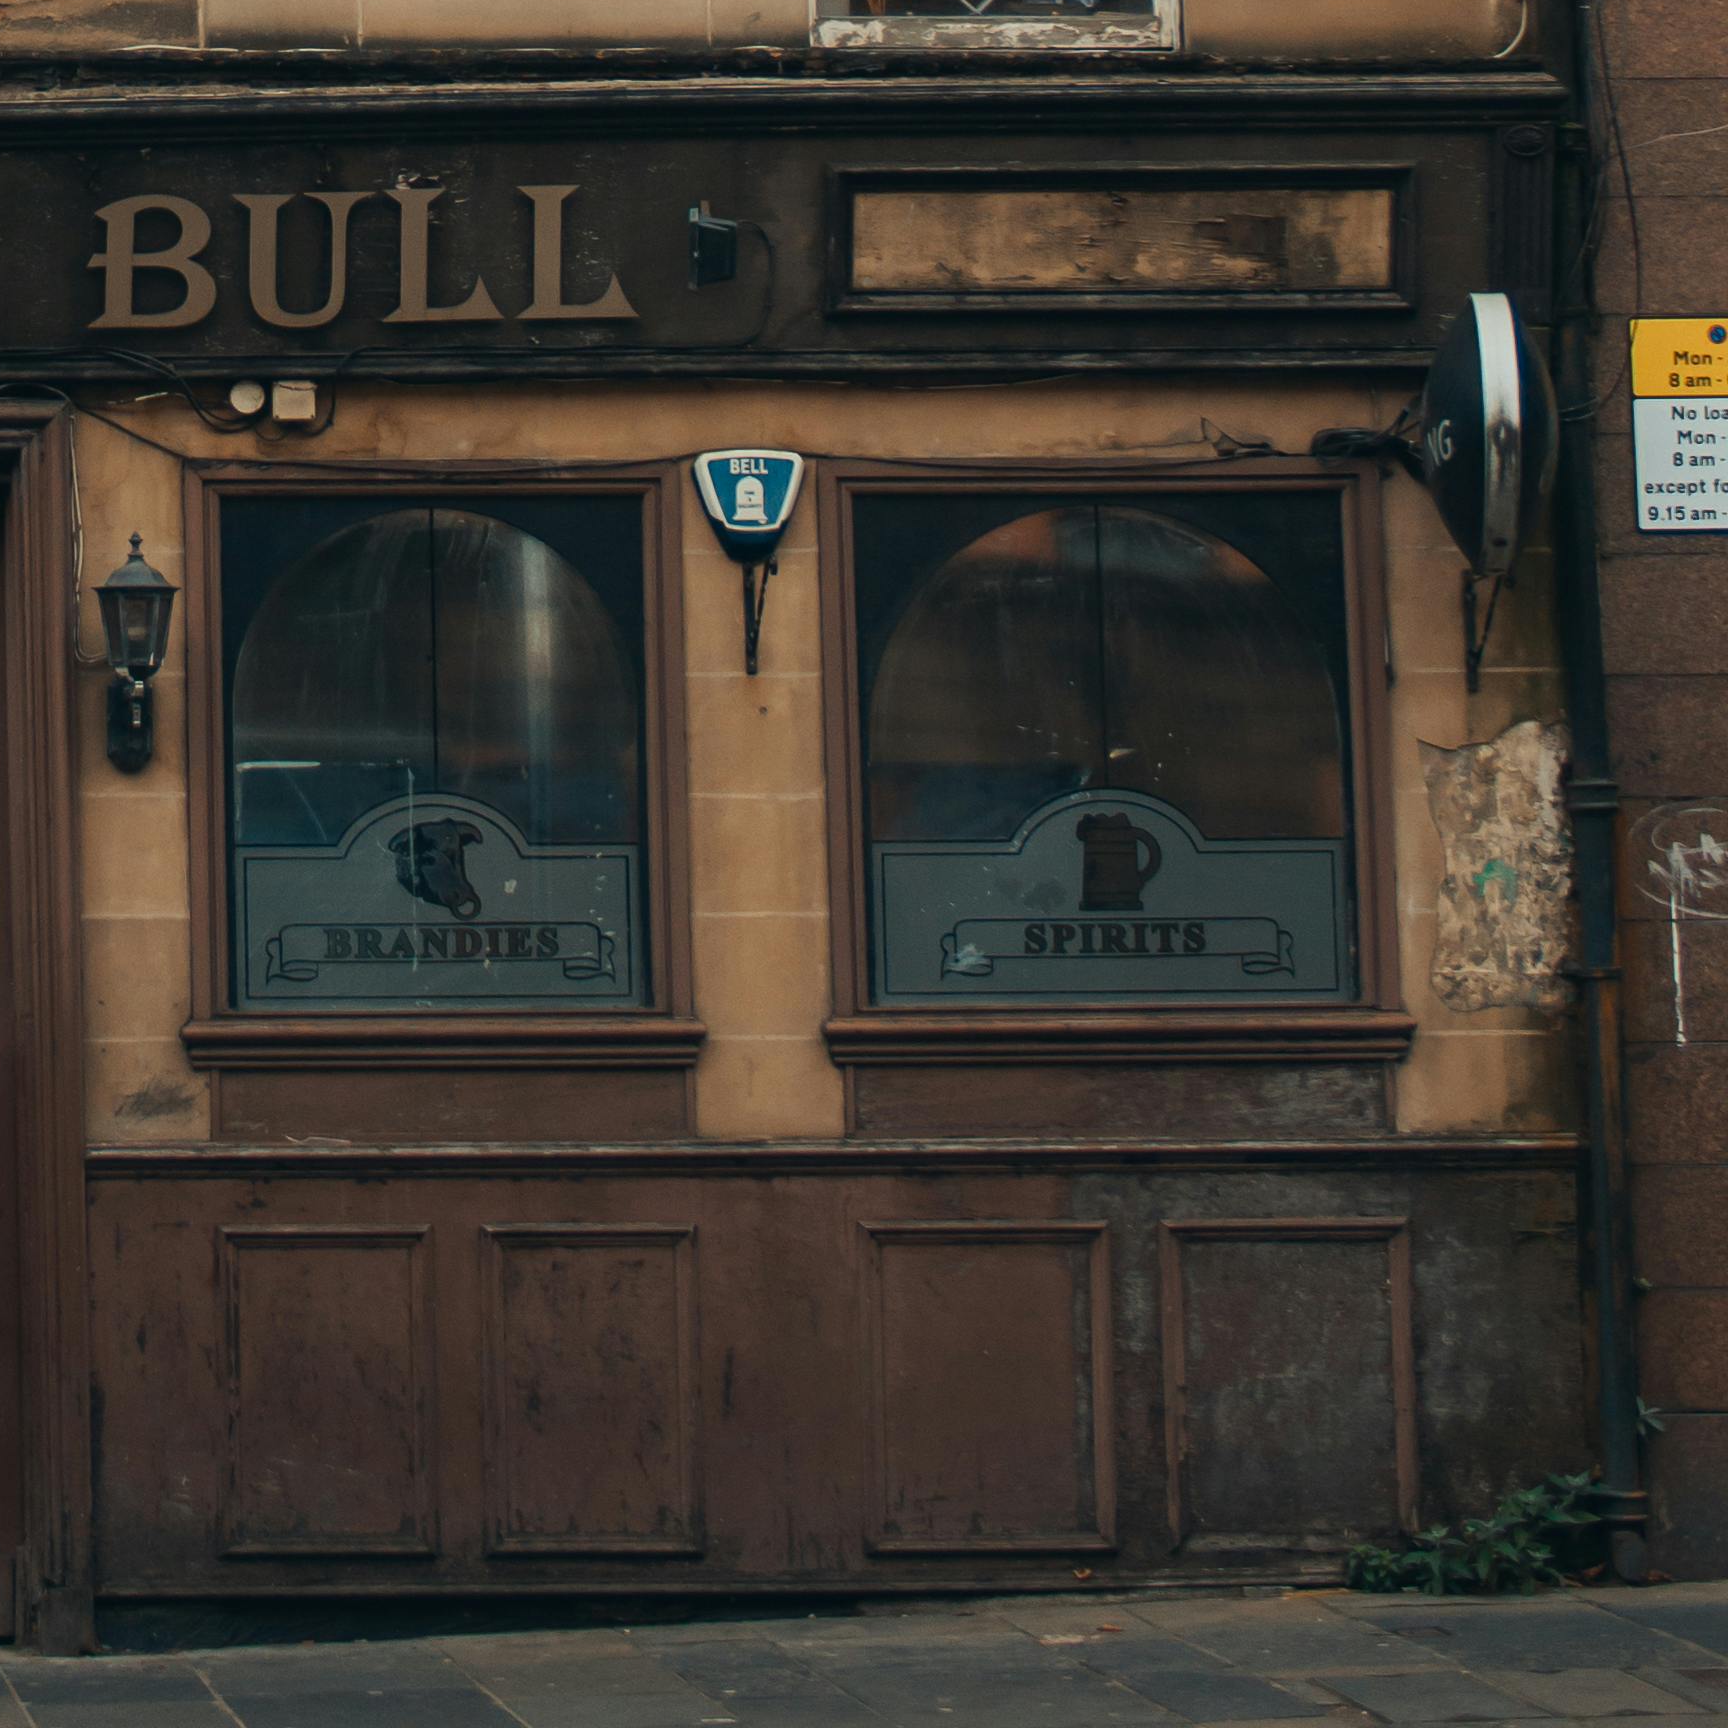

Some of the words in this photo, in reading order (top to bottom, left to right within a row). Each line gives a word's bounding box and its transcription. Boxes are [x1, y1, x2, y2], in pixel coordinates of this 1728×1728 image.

[85, 184, 640, 330] BULL
[1673, 350, 1712, 366] Mon
[1668, 373, 1680, 388] 8
[1685, 376, 1712, 388] am
[1671, 406, 1697, 421] No
[1677, 430, 1716, 445] Mon
[729, 458, 769, 475] BELL
[1673, 452, 1683, 467] 8
[1688, 455, 1715, 467] am
[1644, 480, 1706, 496] except
[1647, 506, 1685, 521] 9.15
[1690, 508, 1717, 521] am
[323, 926, 560, 960] BRANDIES
[1023, 921, 1207, 954] SPIRITS
